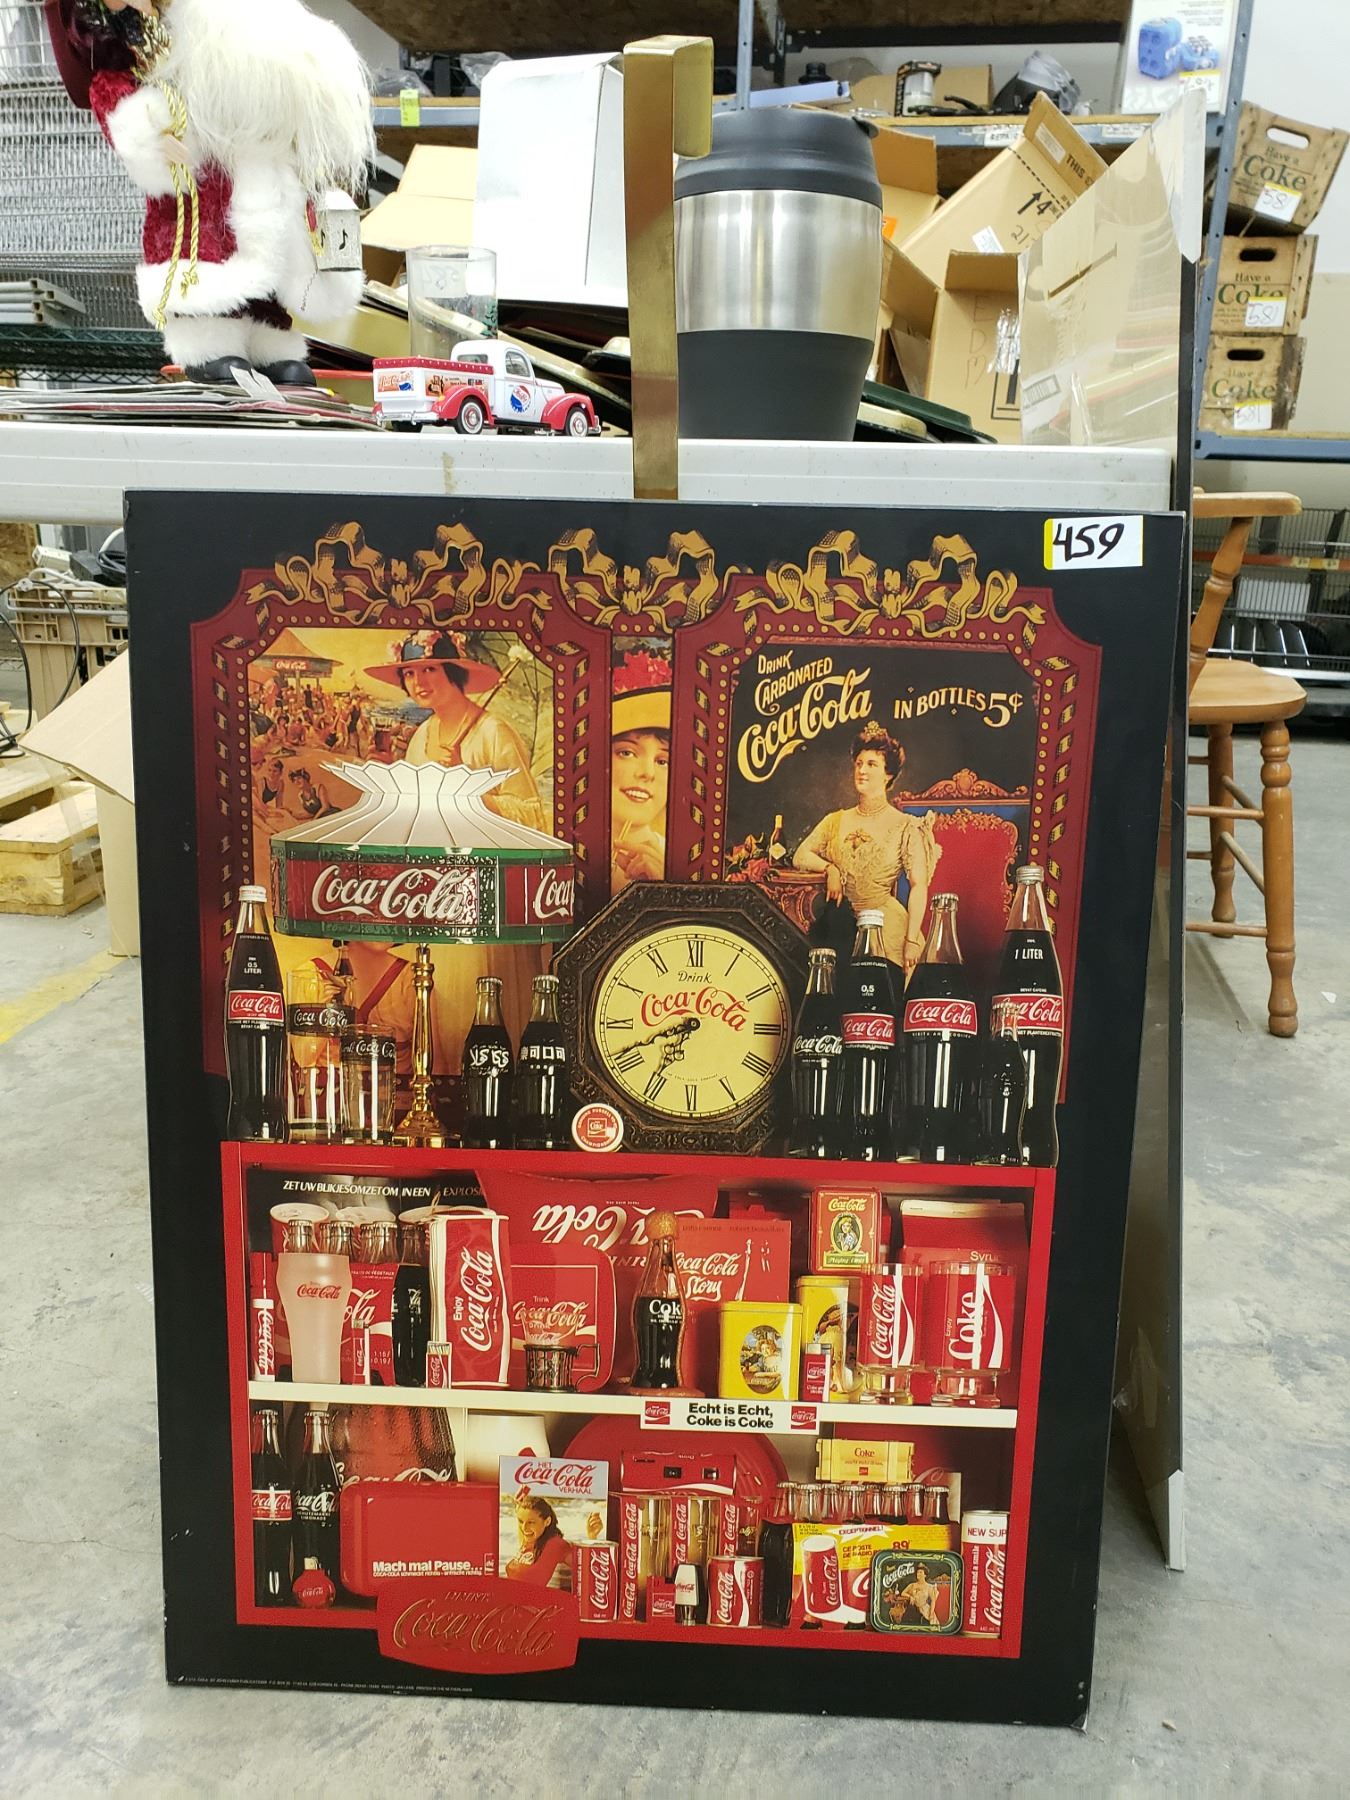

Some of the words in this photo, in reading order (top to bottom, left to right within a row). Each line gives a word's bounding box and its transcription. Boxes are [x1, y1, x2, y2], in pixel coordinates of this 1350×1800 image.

[1066, 154, 1085, 179] THIS
[1243, 155, 1307, 191] Coke
[1212, 378, 1276, 399] Coke
[1052, 523, 1125, 562] 459
[754, 656, 833, 716] CARBONATED
[894, 699, 912, 720] IN
[917, 687, 986, 717] BOTTLES
[983, 691, 1023, 728] 5¢
[737, 667, 872, 783] Coca-Cola
[312, 864, 468, 920] Coca-Cola
[1022, 948, 1044, 960] LITER
[677, 970, 713, 984] Drink
[641, 986, 750, 1032] Coca-Cola
[909, 1002, 972, 1025] Coca-Cola
[844, 1019, 893, 1038] Coca-Cola
[793, 1034, 843, 1055] Coca-Cola
[283, 1181, 300, 1191] ZET
[413, 1187, 431, 1197] EEN
[461, 1246, 493, 1351] Coca-Cola
[686, 1275, 723, 1302] Story
[453, 1296, 464, 1321] Enjoy
[649, 1299, 682, 1315] Cok
[870, 1281, 897, 1360] Coca-Cola
[948, 1291, 983, 1361] Coke
[686, 1415, 722, 1427] Coke
[725, 1416, 736, 1427] is
[738, 1417, 774, 1428] Coke
[689, 1402, 722, 1415] Echt
[723, 1404, 735, 1415] is
[738, 1404, 773, 1418] Echt,
[854, 1448, 875, 1457] Coke
[514, 1461, 597, 1487] Coca-Cola
[559, 1486, 592, 1495] VERHAAL
[626, 1502, 637, 1540] Coca-Cola
[676, 1503, 687, 1540] Coca-Cola
[725, 1504, 735, 1540] Coca-Cola
[967, 1528, 986, 1537] NEW
[373, 1560, 406, 1572] Mach
[408, 1560, 432, 1572] mal
[434, 1560, 482, 1571] Pause...
[626, 1542, 637, 1579] Coca-Cola
[590, 1548, 610, 1610] Coca-Cola
[983, 1547, 1006, 1627] Coca-Cola
[716, 1571, 735, 1624] Coca-Cola
[392, 1599, 565, 1656] Coca-Cola
